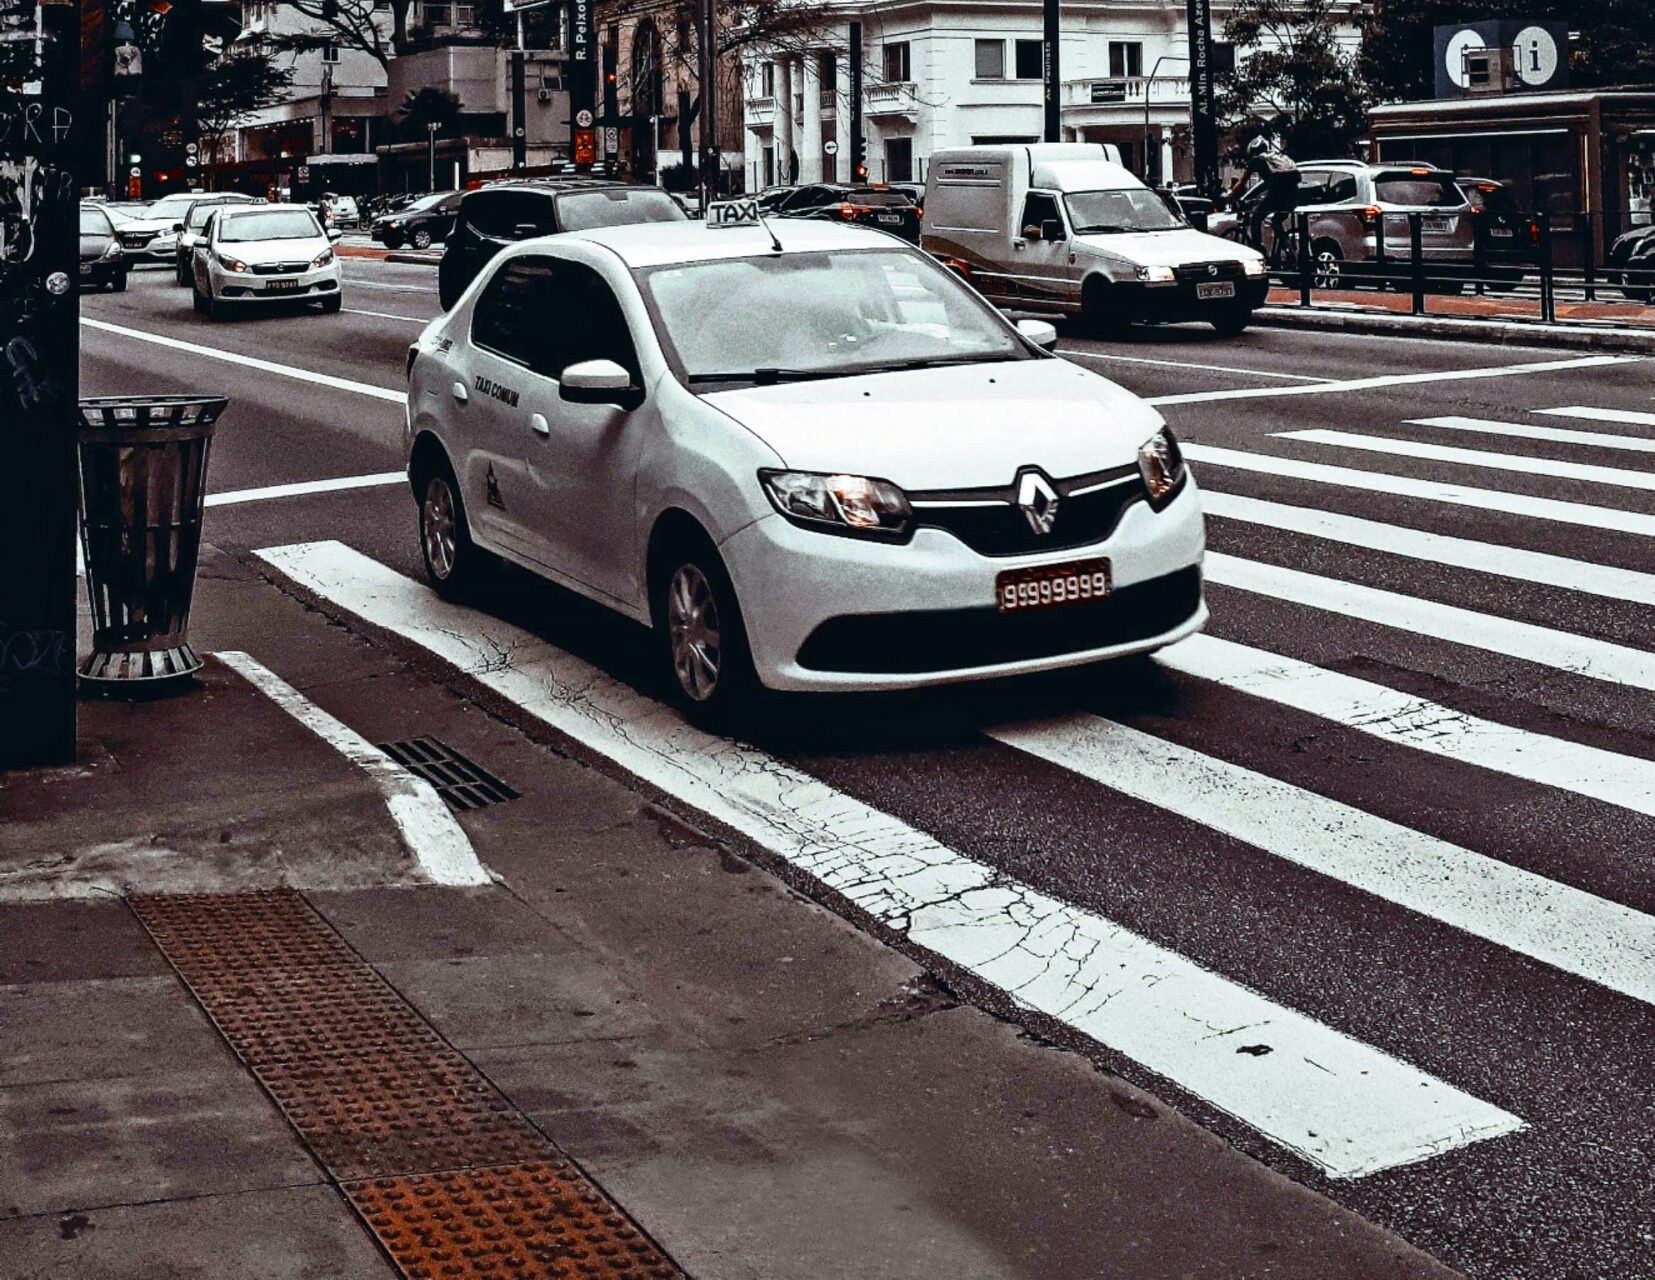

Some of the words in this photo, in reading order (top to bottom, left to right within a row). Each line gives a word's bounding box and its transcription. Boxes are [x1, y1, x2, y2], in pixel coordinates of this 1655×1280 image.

[575, 47, 587, 61] R.
[1196, 29, 1206, 68] Rocha
[710, 203, 757, 223] TAXI
[474, 375, 492, 396] TAXI
